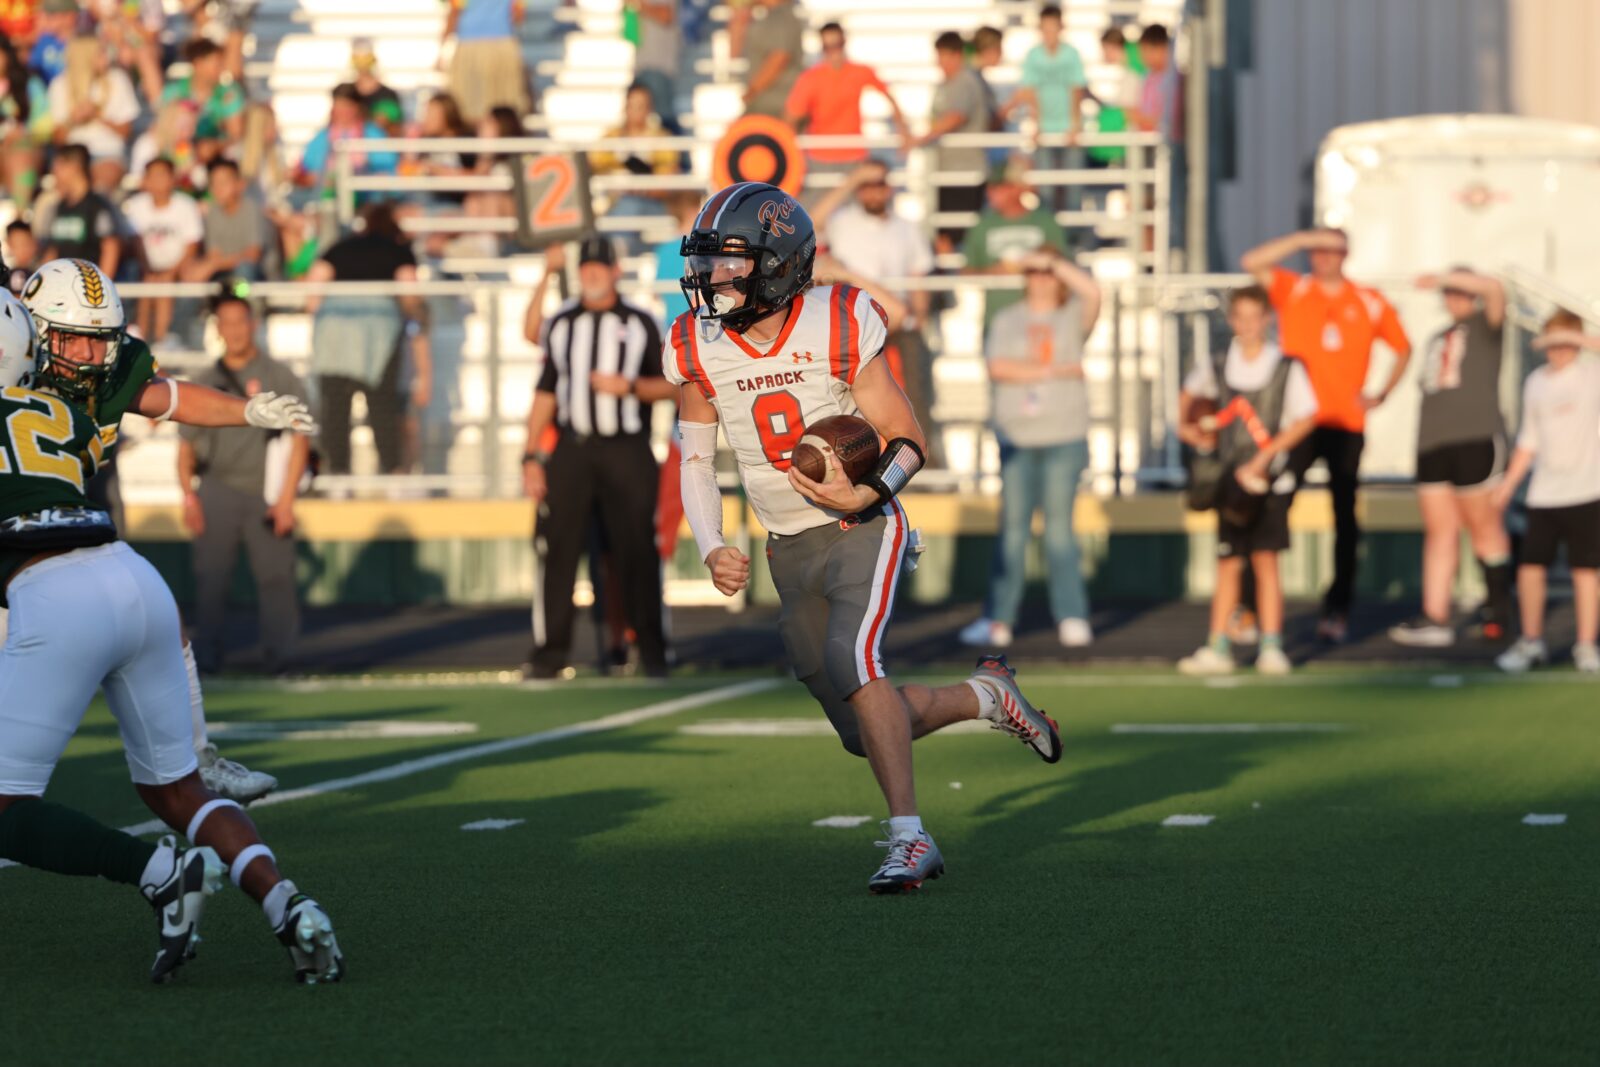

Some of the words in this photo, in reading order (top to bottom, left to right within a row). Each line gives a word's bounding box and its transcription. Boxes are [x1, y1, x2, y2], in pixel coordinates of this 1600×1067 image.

[528, 155, 581, 230] 2
[736, 371, 805, 392] CAPROCK
[751, 390, 806, 473] 8
